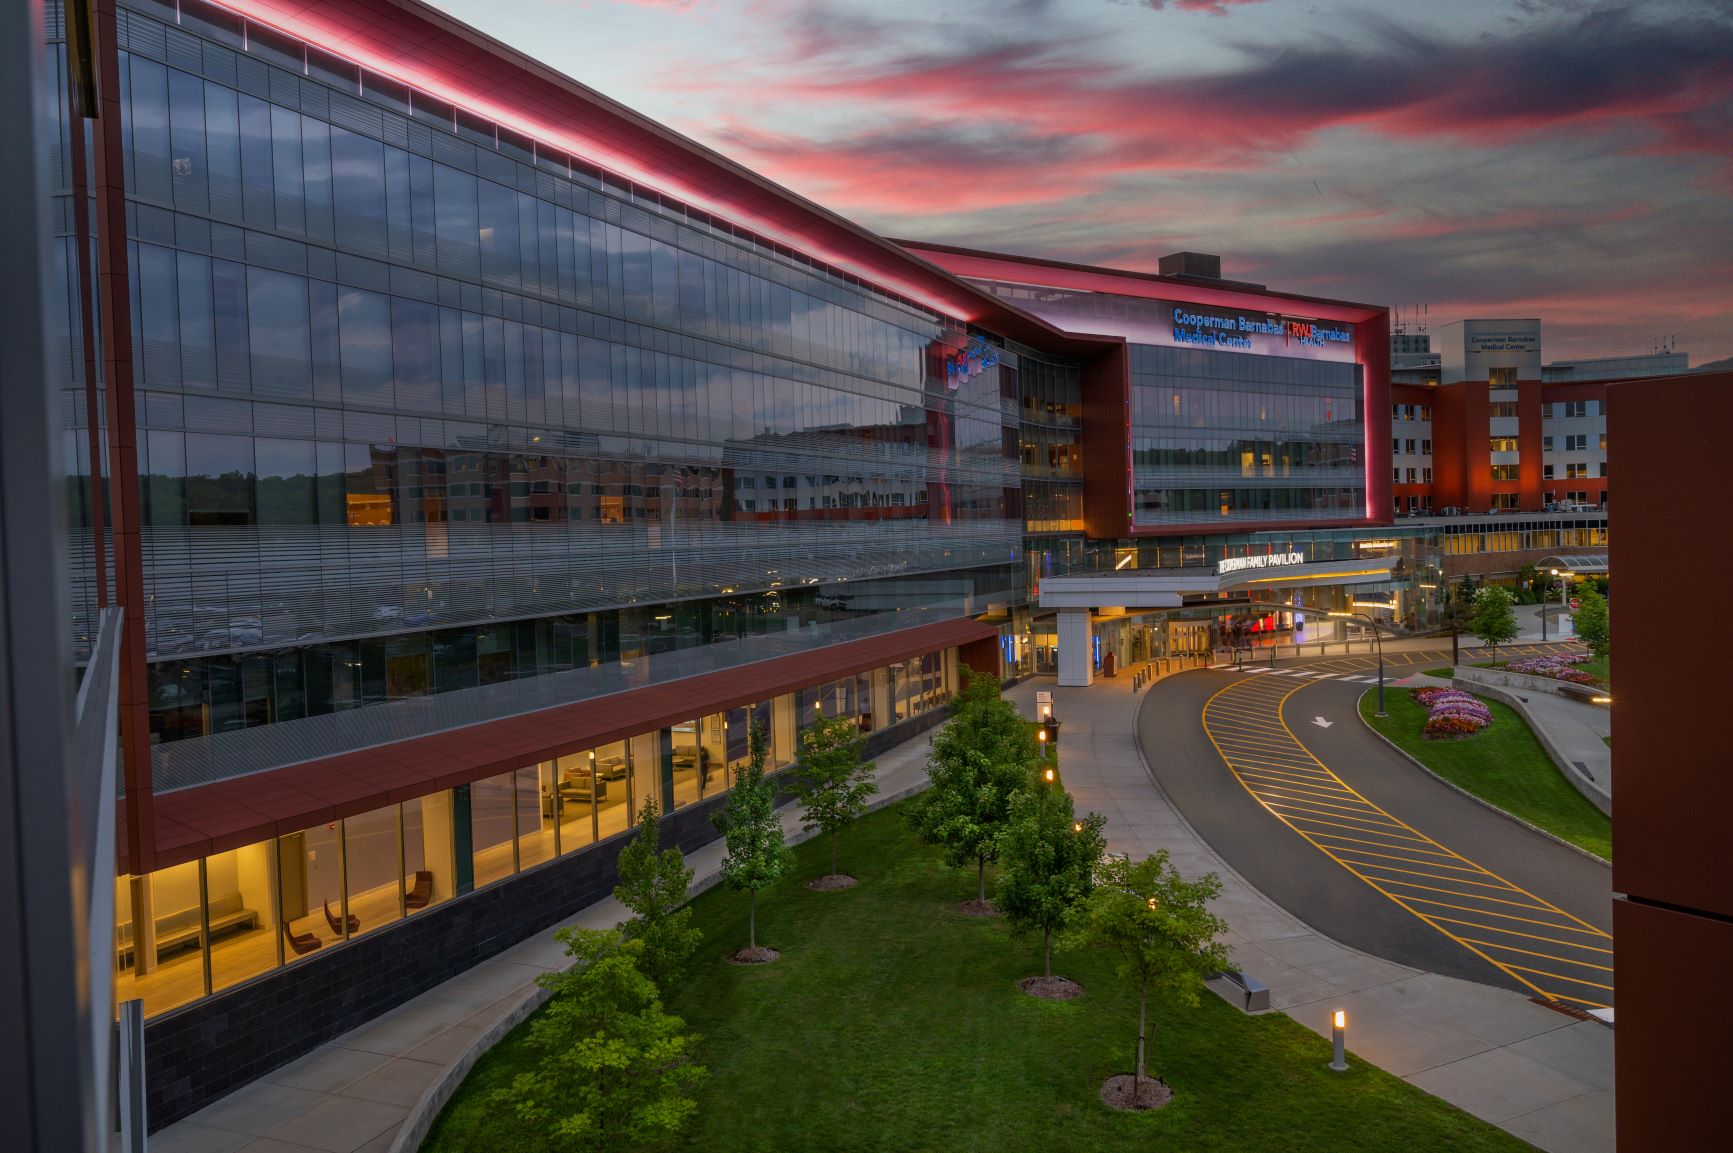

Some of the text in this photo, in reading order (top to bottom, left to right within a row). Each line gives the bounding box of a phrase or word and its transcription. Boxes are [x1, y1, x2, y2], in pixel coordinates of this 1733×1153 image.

[1174, 308, 1284, 335] Cooperman Barnabas
[1174, 328, 1251, 348] Medical Center
[1472, 336, 1506, 344] Cooperman
[1247, 555, 1268, 569] FAMILY
[1268, 552, 1304, 566] PAVILION
